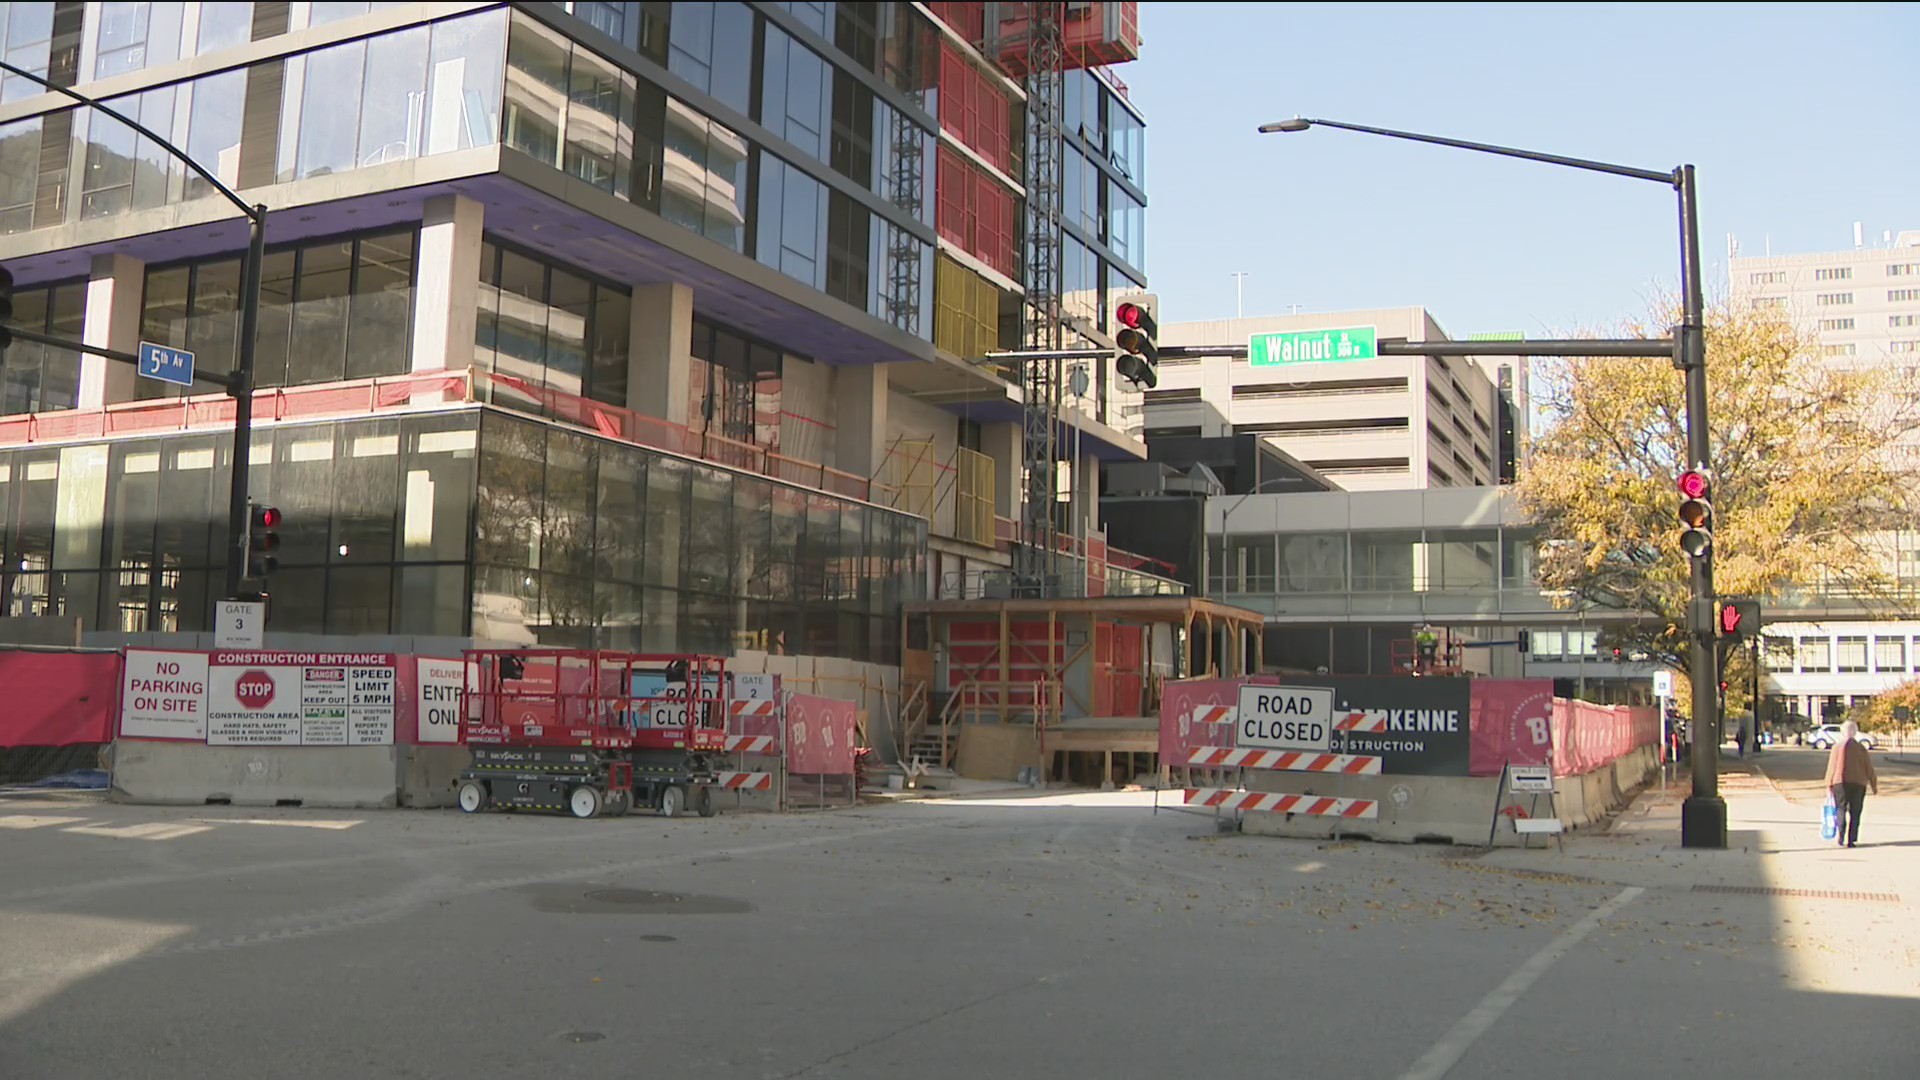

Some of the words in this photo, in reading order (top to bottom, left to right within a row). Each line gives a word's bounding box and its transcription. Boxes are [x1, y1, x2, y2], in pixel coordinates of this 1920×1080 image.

[1265, 332, 1332, 363] Walnut
[151, 349, 169, 374] 5th
[172, 353, 183, 368] Av
[225, 605, 252, 614] GATE
[235, 618, 243, 630] 3
[218, 653, 316, 664] CONSTRUCTION
[319, 654, 387, 665] ENTRANCE
[156, 662, 180, 676] NO
[310, 670, 339, 679] DANGER
[352, 669, 392, 679] SPEED
[430, 668, 465, 679] DELIVER
[130, 679, 203, 694] PARKING
[355, 682, 389, 691] LIMIT
[742, 677, 763, 685] GATE
[239, 683, 272, 696] STOP
[750, 689, 757, 698] 2
[134, 697, 157, 711] ON
[162, 698, 198, 713] SITE
[353, 695, 360, 704] 5
[364, 695, 391, 704] MPH
[1257, 695, 1312, 715] ROAD
[428, 708, 460, 725] ONL
[656, 709, 703, 726] CLOS
[1350, 709, 1458, 732] RKENNE
[468, 726, 501, 735] SKYJACK
[1244, 720, 1323, 742] CLOSED
[1330, 740, 1425, 752] OSTRUCTION
[490, 751, 524, 760] SKYJACK
